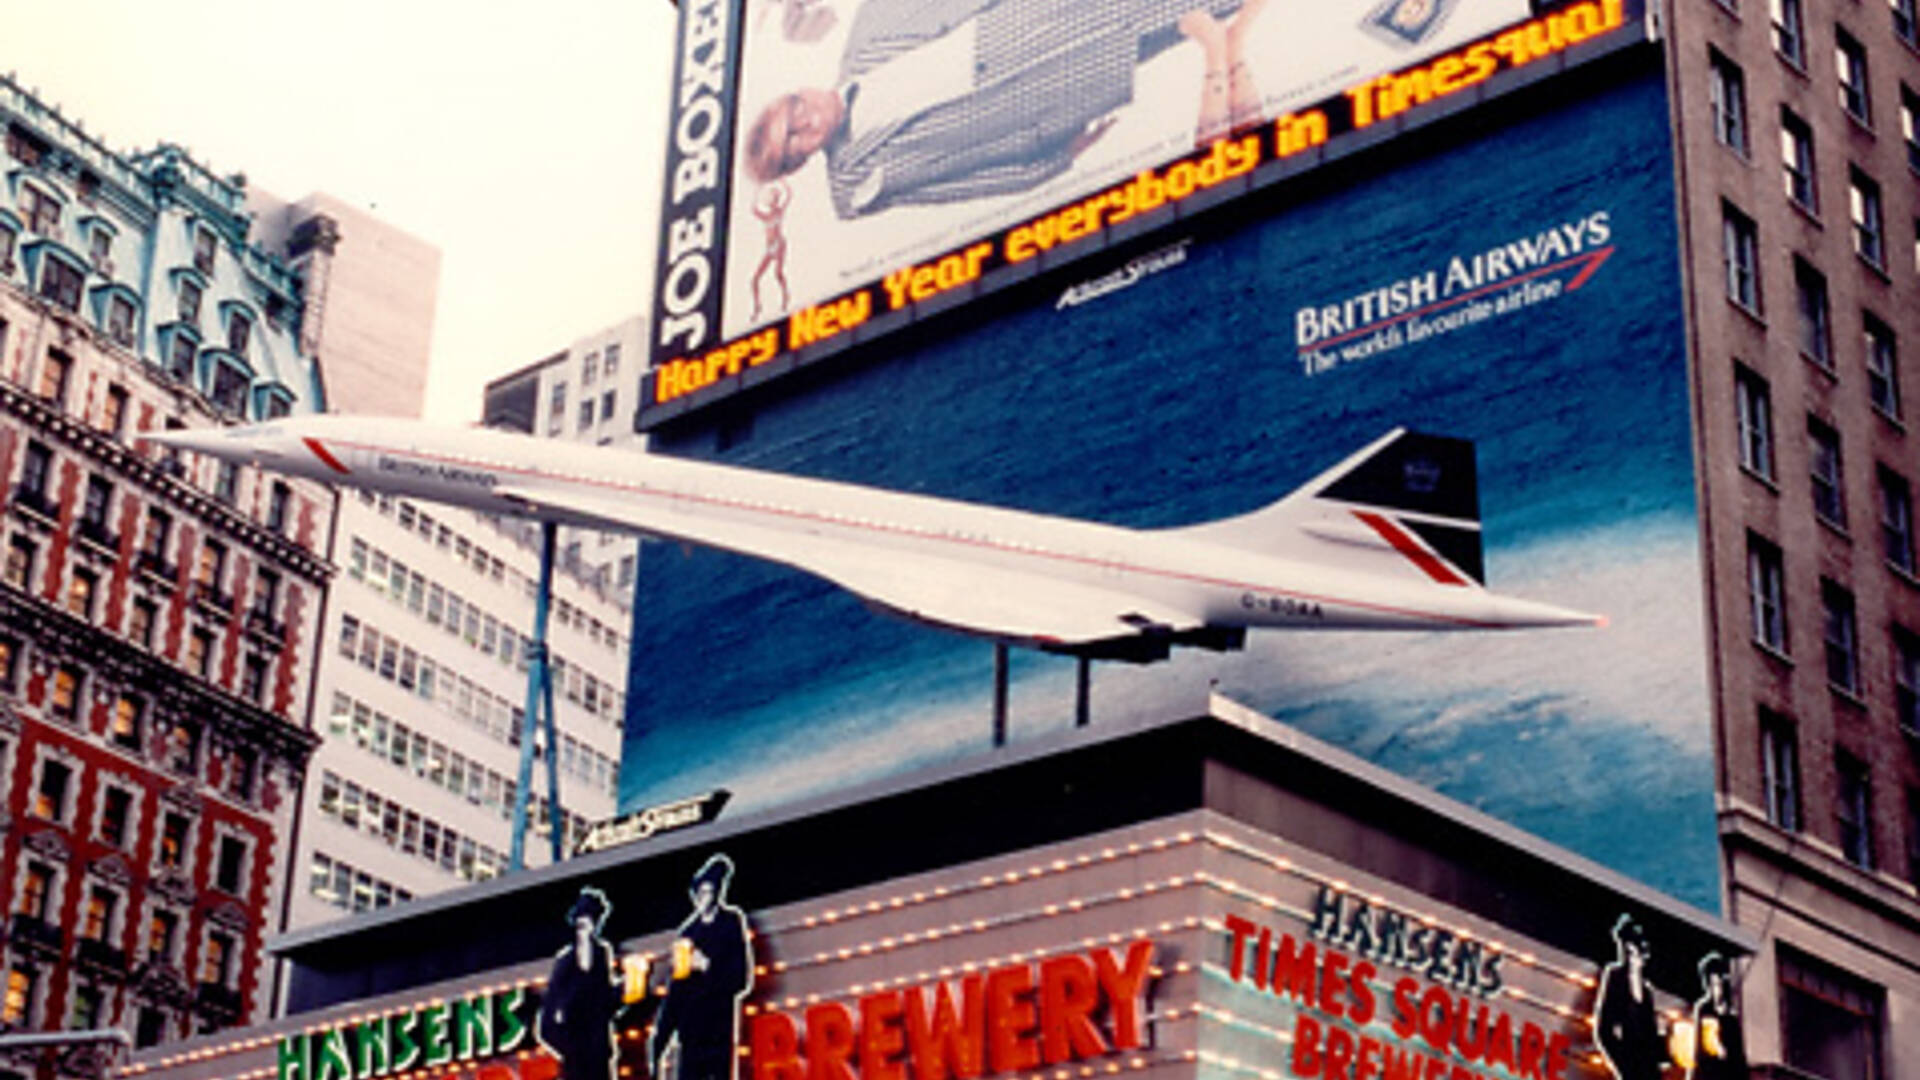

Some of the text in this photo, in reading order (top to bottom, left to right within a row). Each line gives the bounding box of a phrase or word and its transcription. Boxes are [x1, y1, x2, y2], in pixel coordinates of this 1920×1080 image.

[660, 0, 728, 350] JOE BOXE
[656, 328, 778, 403] Happy
[788, 290, 872, 350] New
[882, 242, 993, 312] Year
[1004, 137, 1260, 264] everybody
[1275, 109, 1328, 157] in
[1296, 210, 1612, 346] BRITISH AIRWAYS
[1298, 349, 1338, 377] The
[1406, 299, 1493, 343] favourite
[1495, 279, 1562, 314] airline
[1226, 913, 1572, 1080] TIMES SQUARE
[1311, 884, 1504, 996] HANSENS
[277, 987, 528, 1080] HANSENS
[751, 940, 1153, 1080] BREWERY
[1290, 1012, 1500, 1080] BREW
